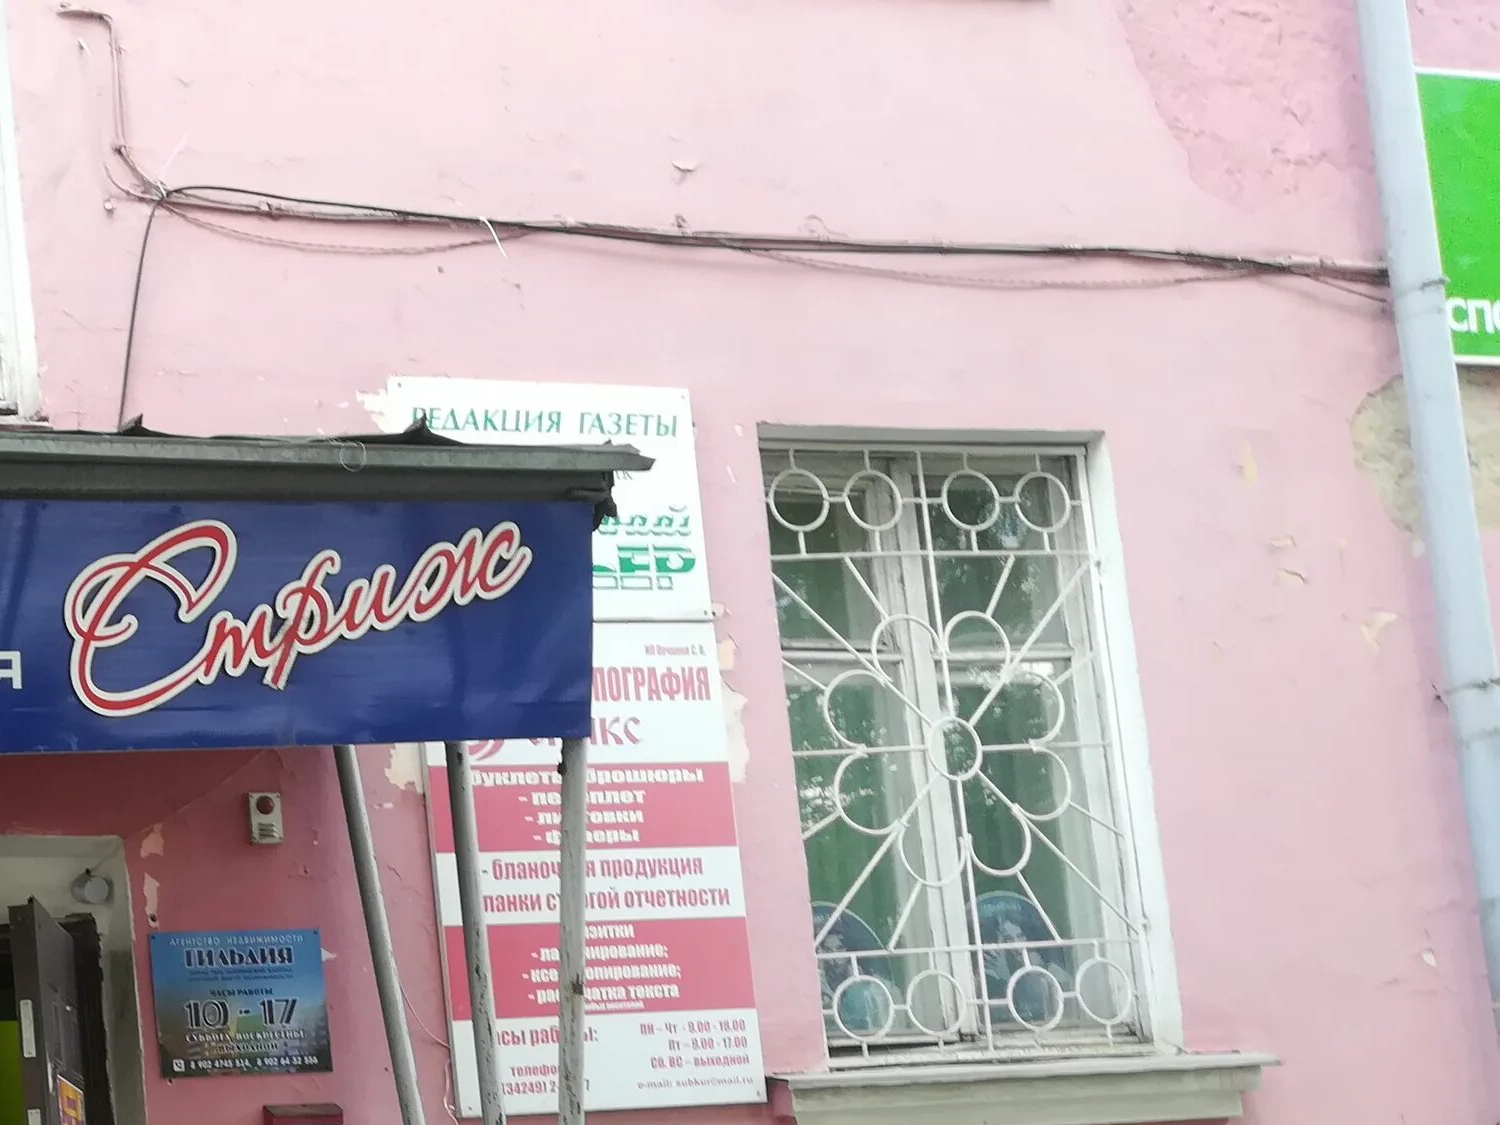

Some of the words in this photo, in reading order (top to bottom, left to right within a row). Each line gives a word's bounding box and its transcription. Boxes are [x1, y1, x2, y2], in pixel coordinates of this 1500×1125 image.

[579, 412, 677, 438] ГАЗЕТЫ
[65, 519, 533, 718] Стриж
[592, 666, 711, 702] ПОГРАФИЯ
[600, 857, 703, 879] продукция
[482, 893, 542, 913] ланки
[624, 888, 730, 910] отчетности
[184, 946, 293, 968] ГИЛЬДИЯ
[184, 1000, 230, 1030] 10
[259, 997, 299, 1025] 17
[511, 1063, 559, 1079] телефо
